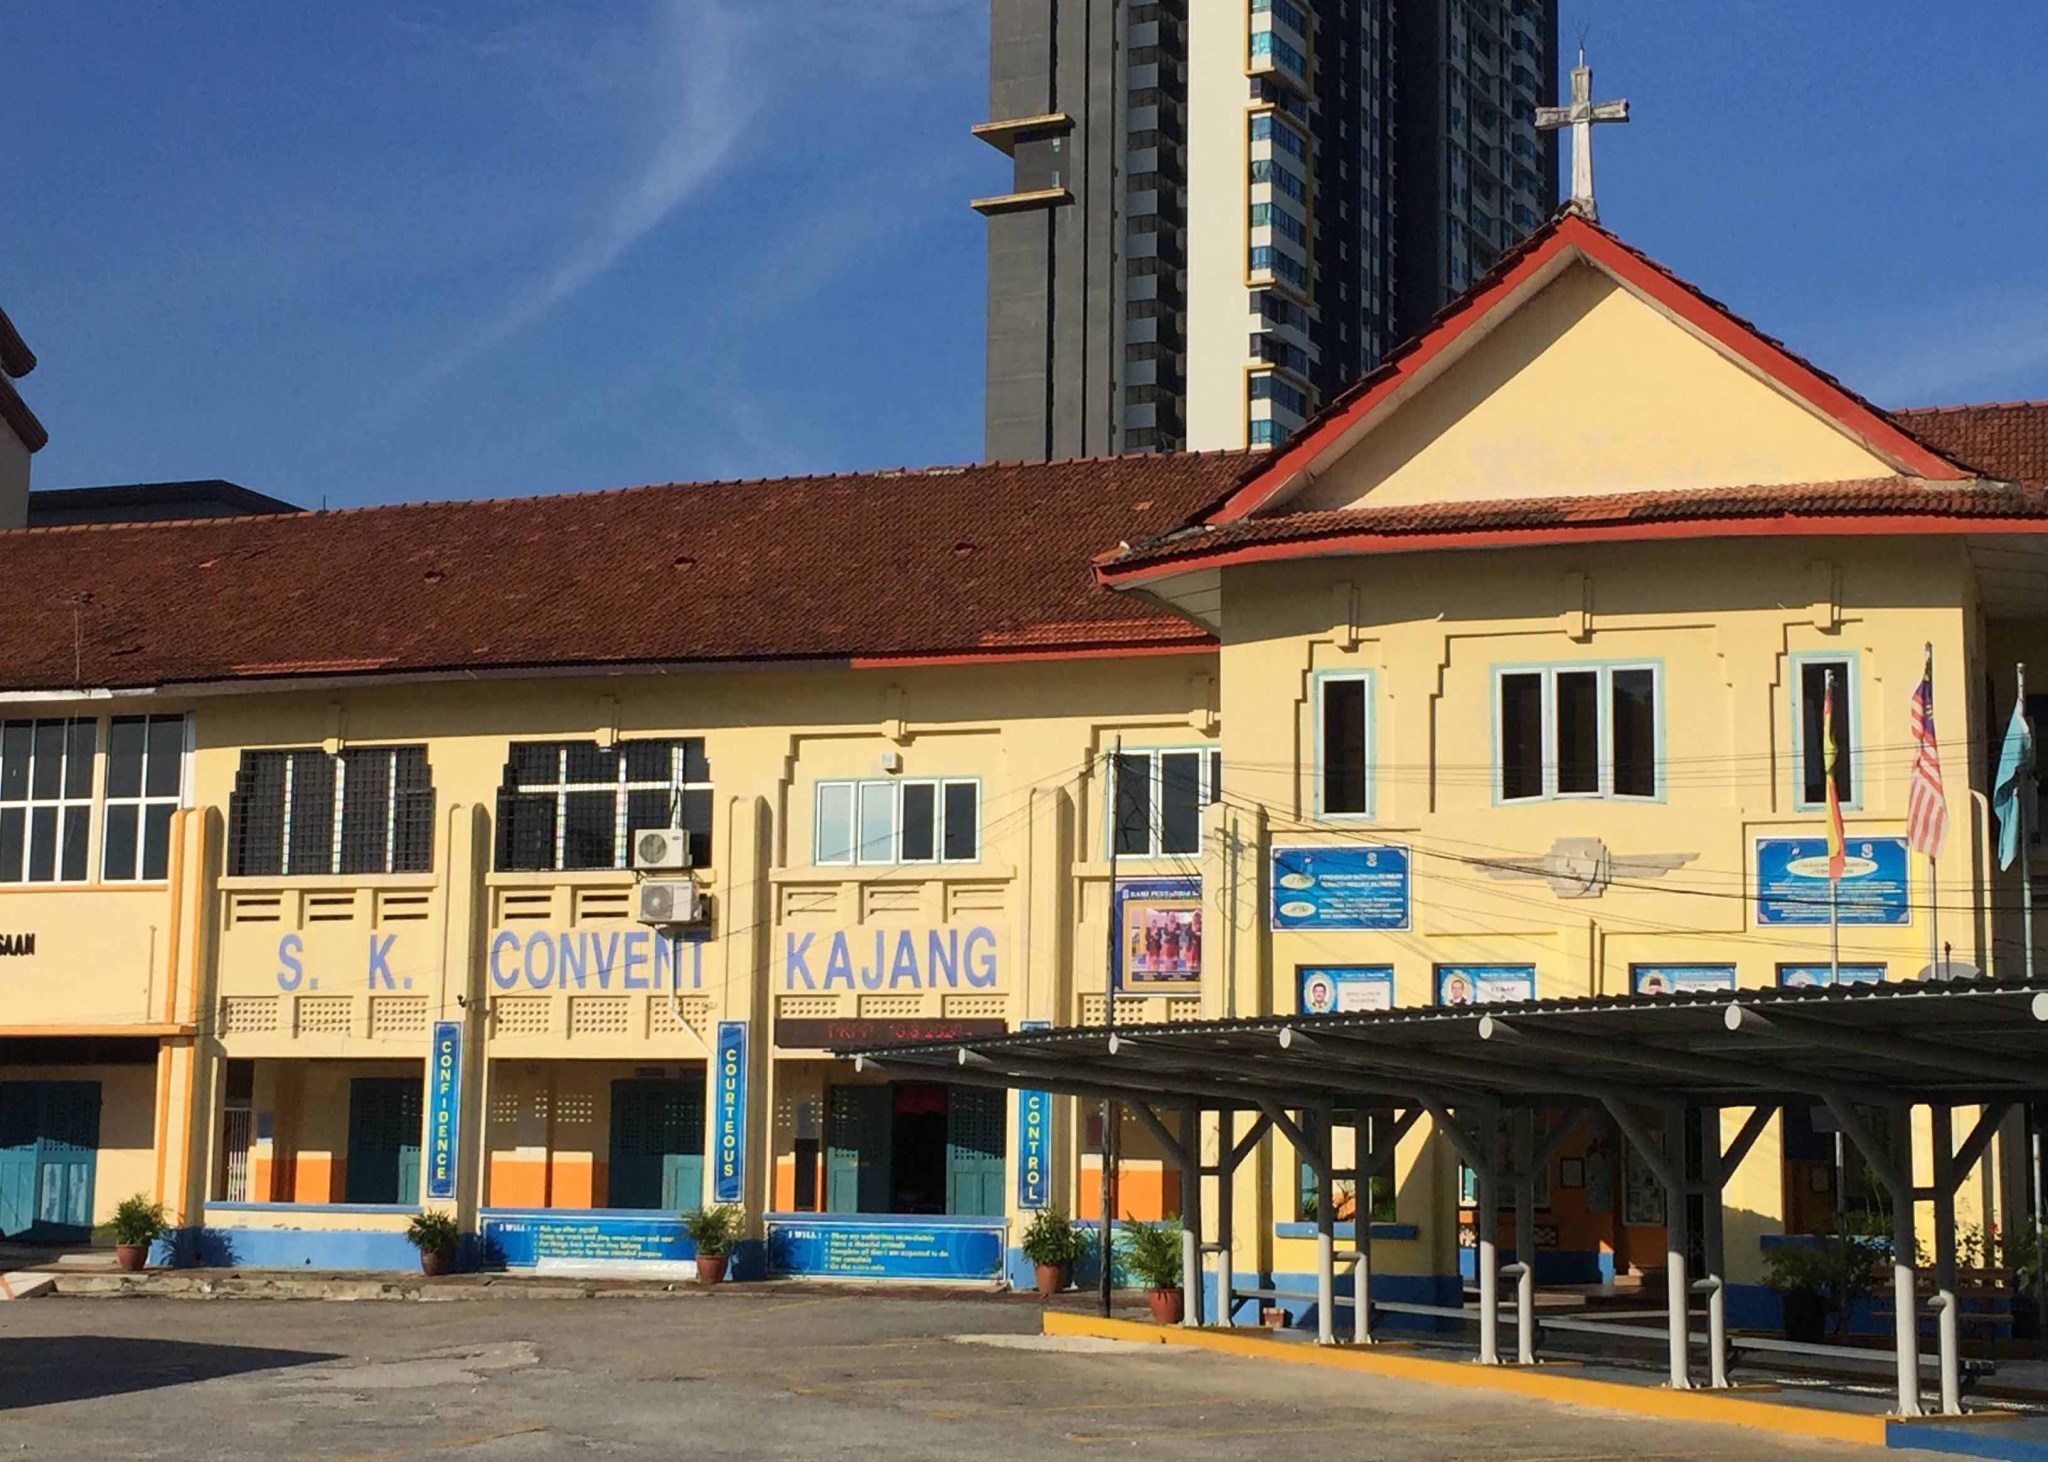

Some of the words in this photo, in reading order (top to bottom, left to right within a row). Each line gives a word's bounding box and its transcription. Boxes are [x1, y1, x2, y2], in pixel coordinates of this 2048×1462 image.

[491, 931, 703, 990] CONVENT
[785, 926, 998, 990] KAJANG
[436, 1040, 453, 1180] CONFIDENCE
[723, 1049, 738, 1177] COURTEOUS
[1027, 1096, 1041, 1200] CONTROL
